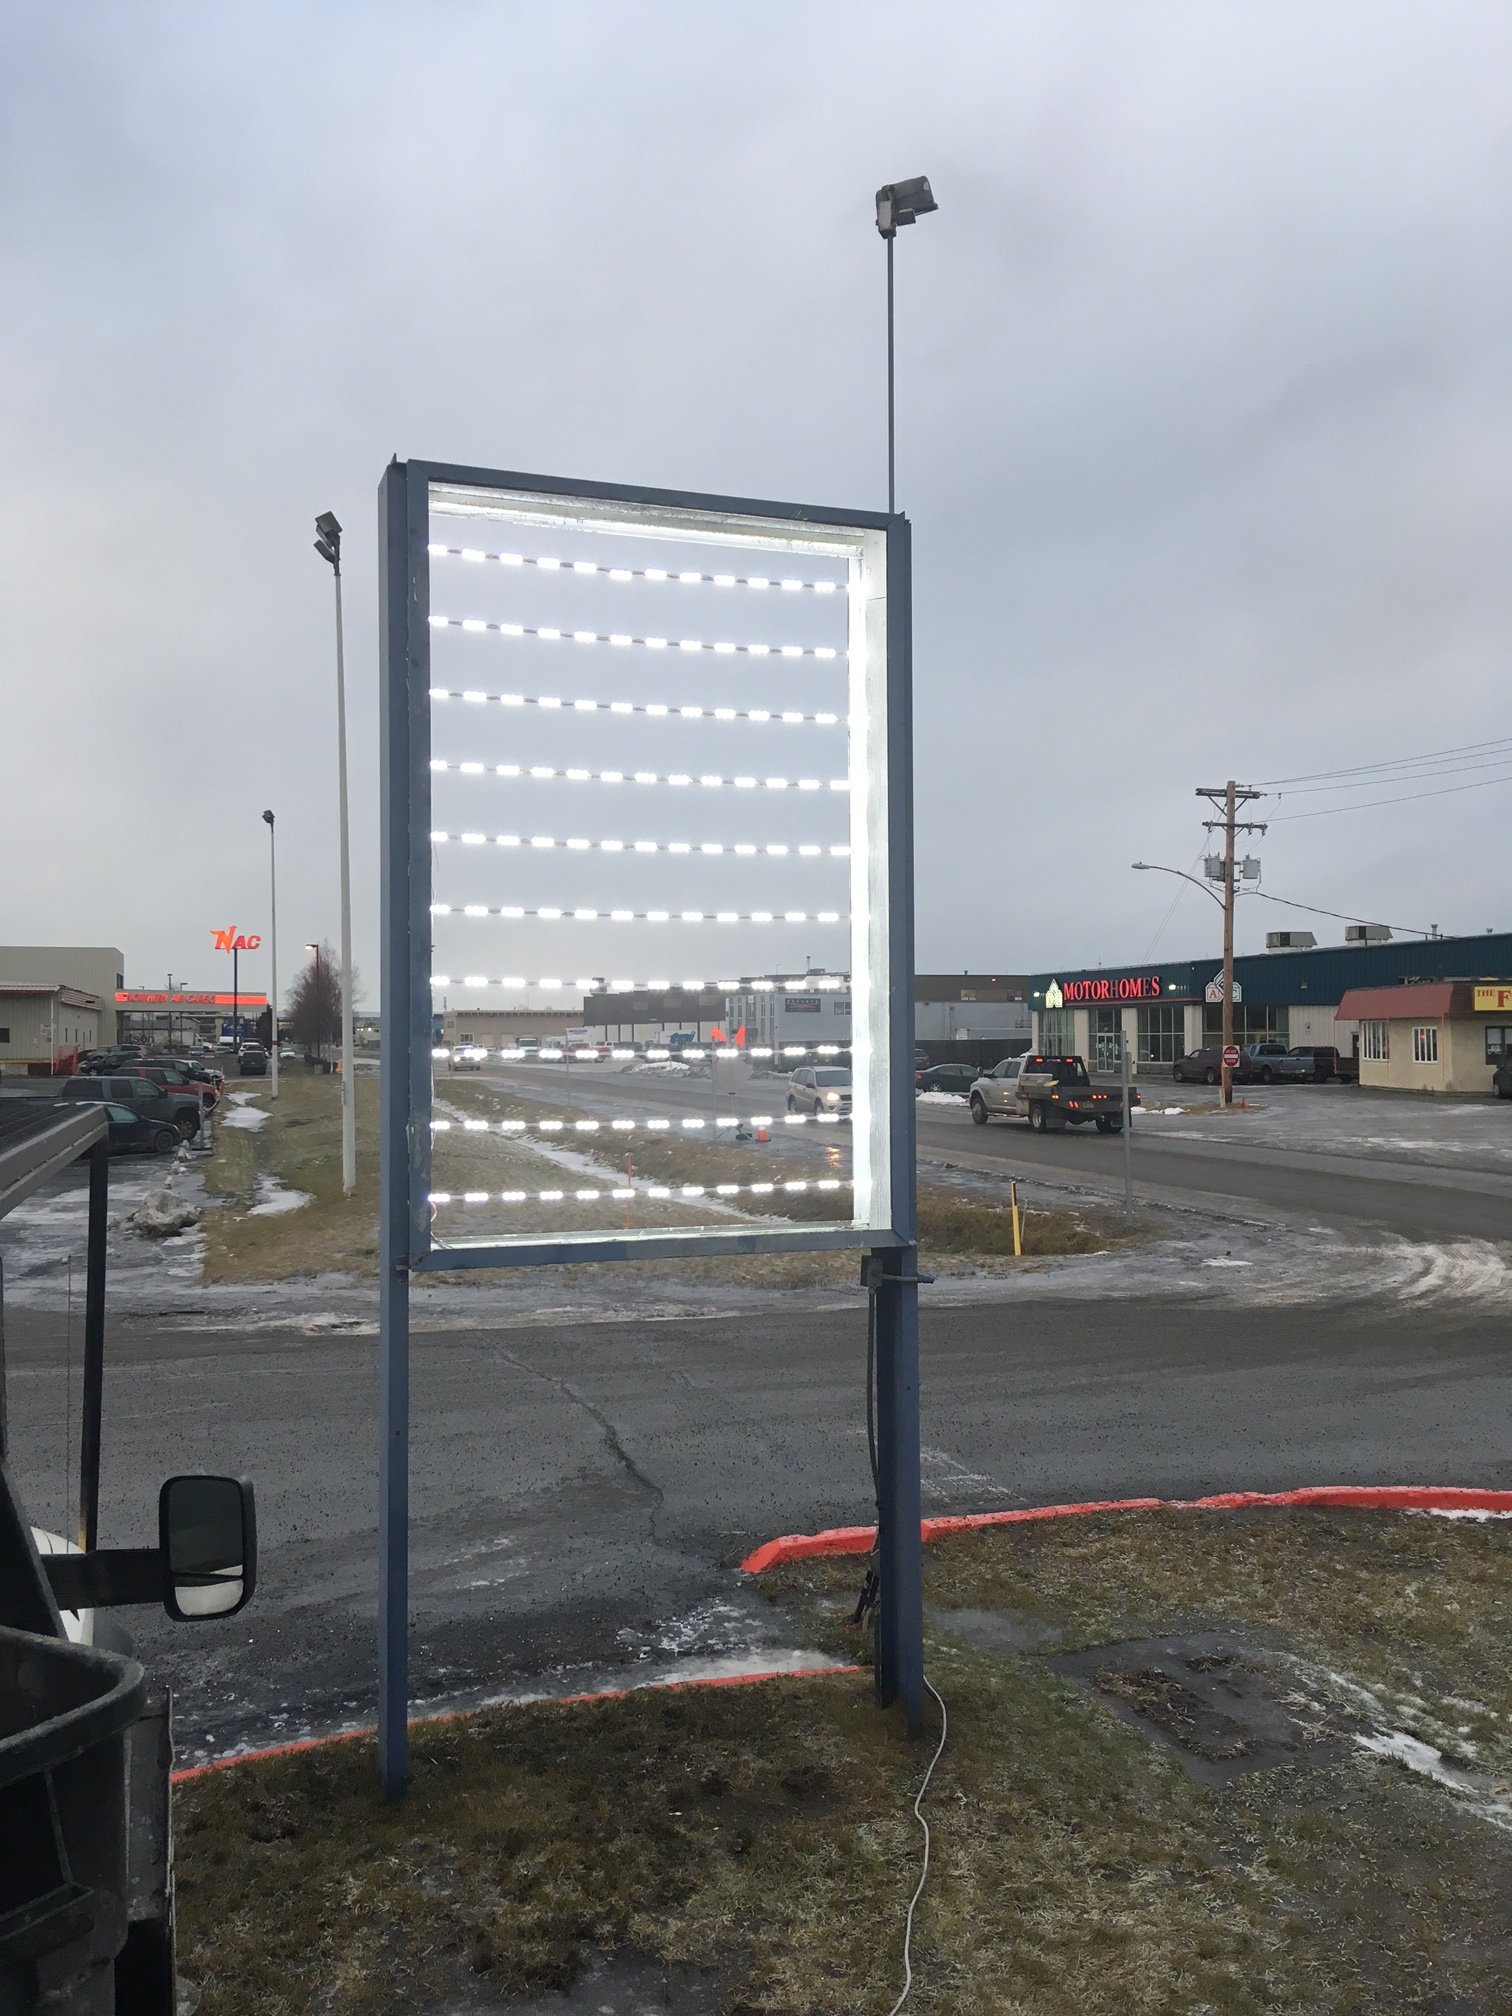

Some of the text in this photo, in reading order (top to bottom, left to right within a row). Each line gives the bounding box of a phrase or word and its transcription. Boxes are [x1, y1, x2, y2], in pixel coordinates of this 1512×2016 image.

[210, 925, 262, 953] NAC
[127, 993, 168, 1003] NORTHERN
[1064, 976, 1160, 1001] MOTORHOMES
[1497, 990, 1512, 1008] F
